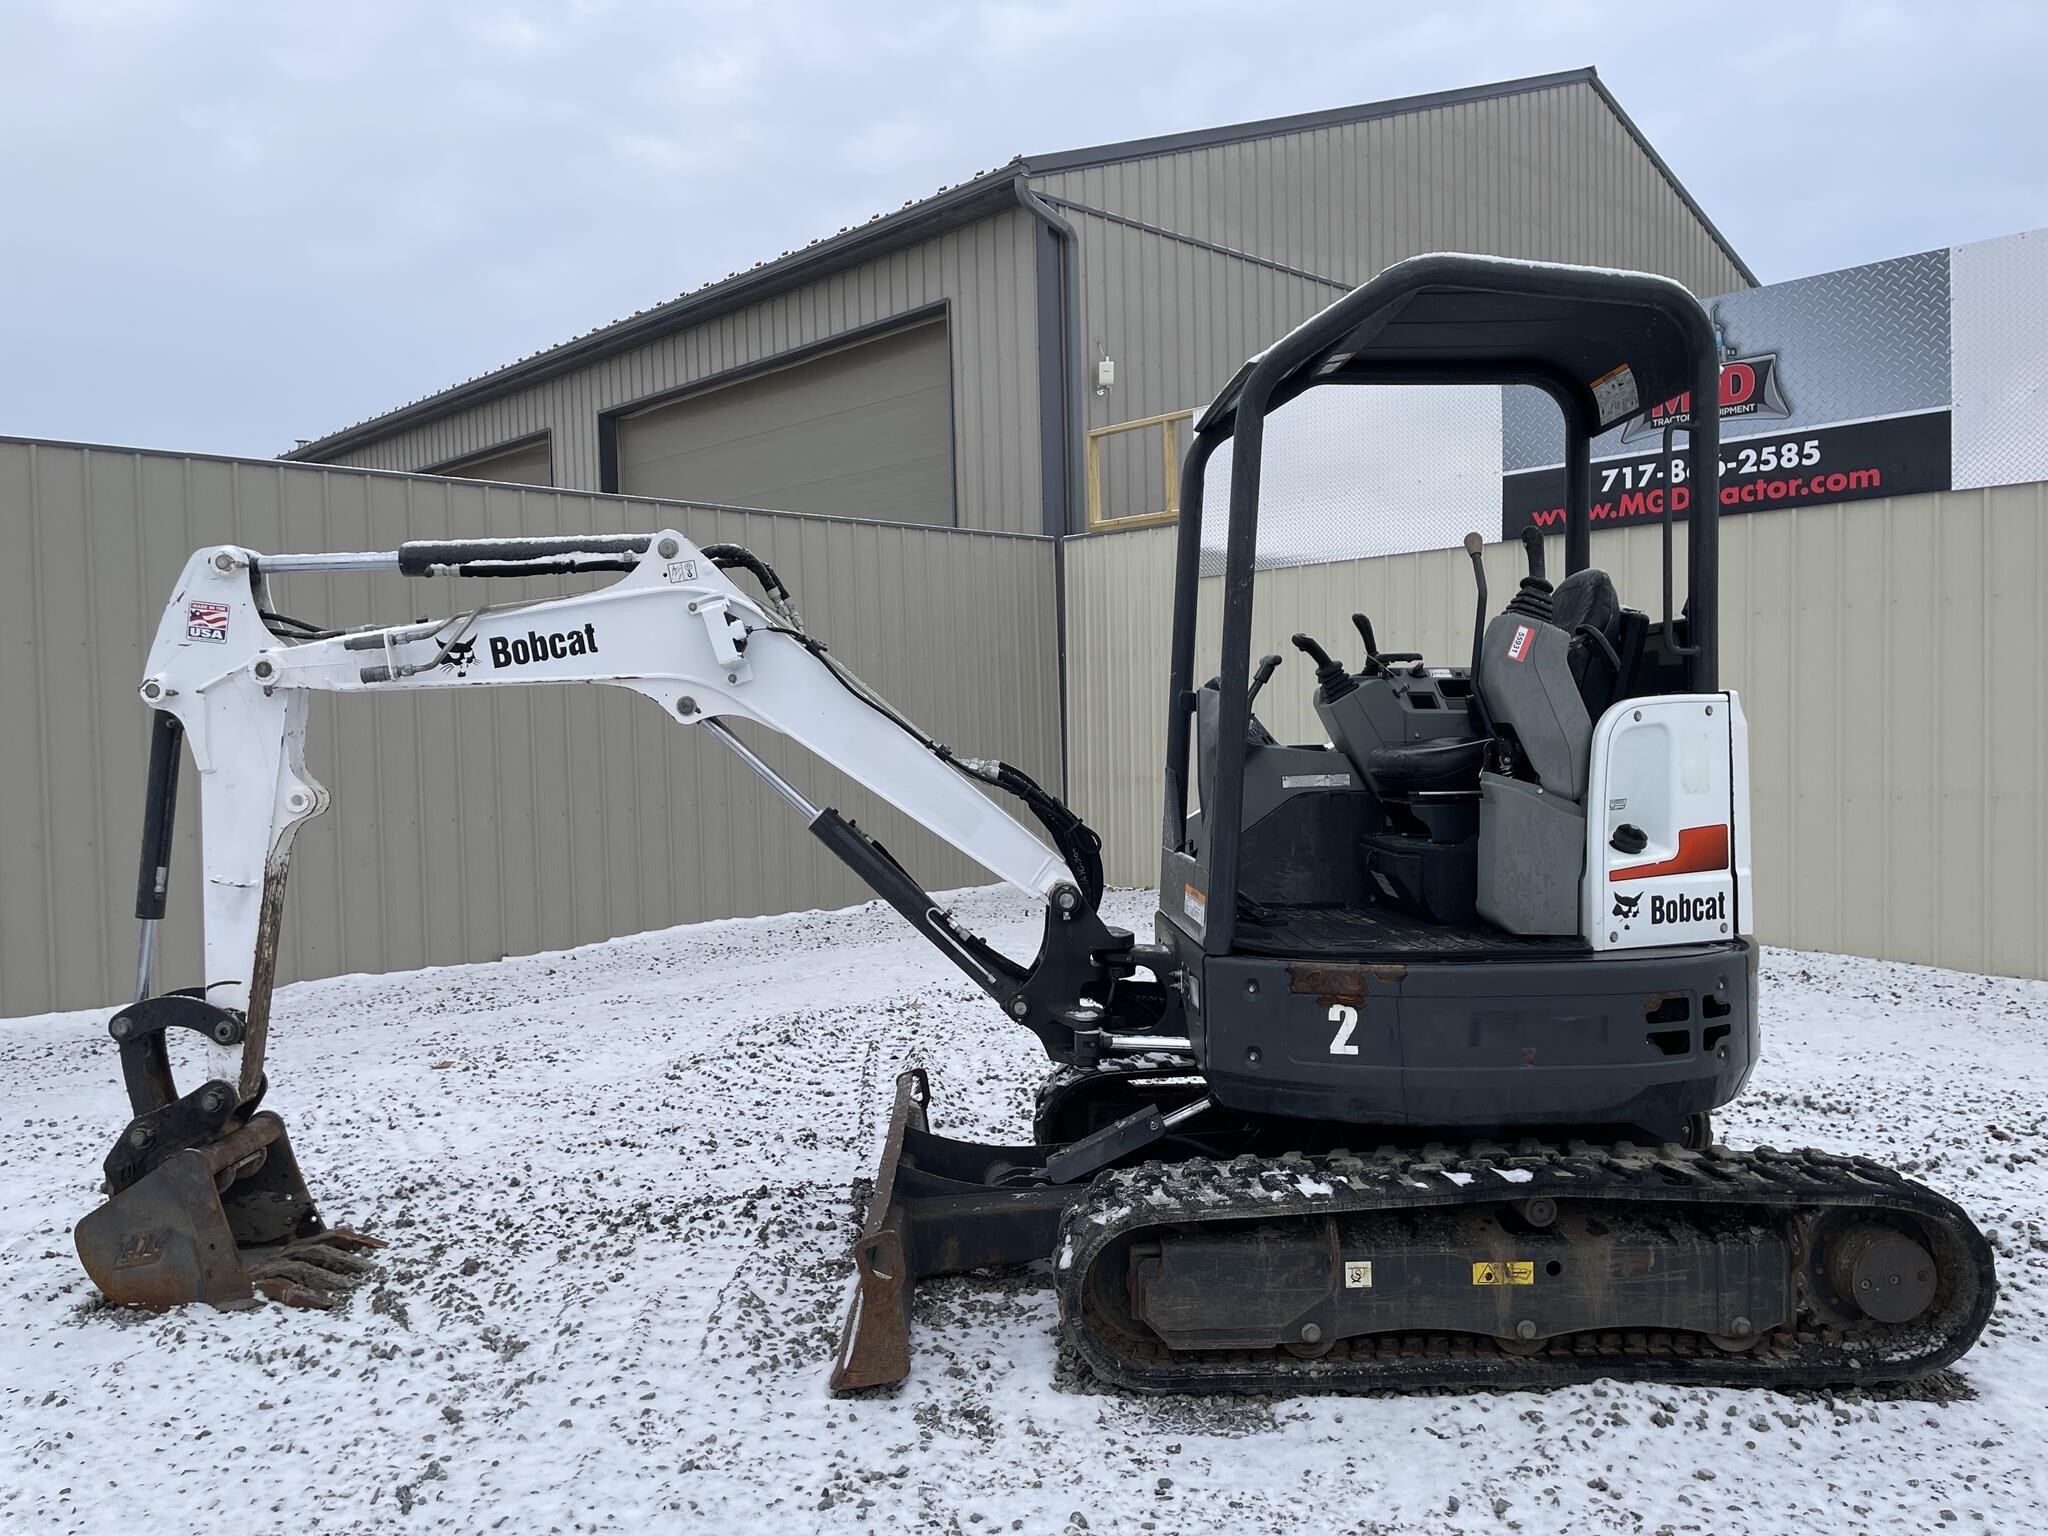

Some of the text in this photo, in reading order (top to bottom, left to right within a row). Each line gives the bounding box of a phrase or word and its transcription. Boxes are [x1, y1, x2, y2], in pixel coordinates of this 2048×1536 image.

[1652, 414, 1690, 427] TRACTO
[1602, 440, 1821, 492] 717-8-2585
[1532, 467, 1881, 527] ww.MGDactor.com
[190, 627, 224, 640] USA
[489, 623, 598, 669] Bobcat
[1511, 631, 1525, 653] 55931
[1651, 891, 1726, 925] Bobcat
[1328, 1003, 1359, 1055] 2
